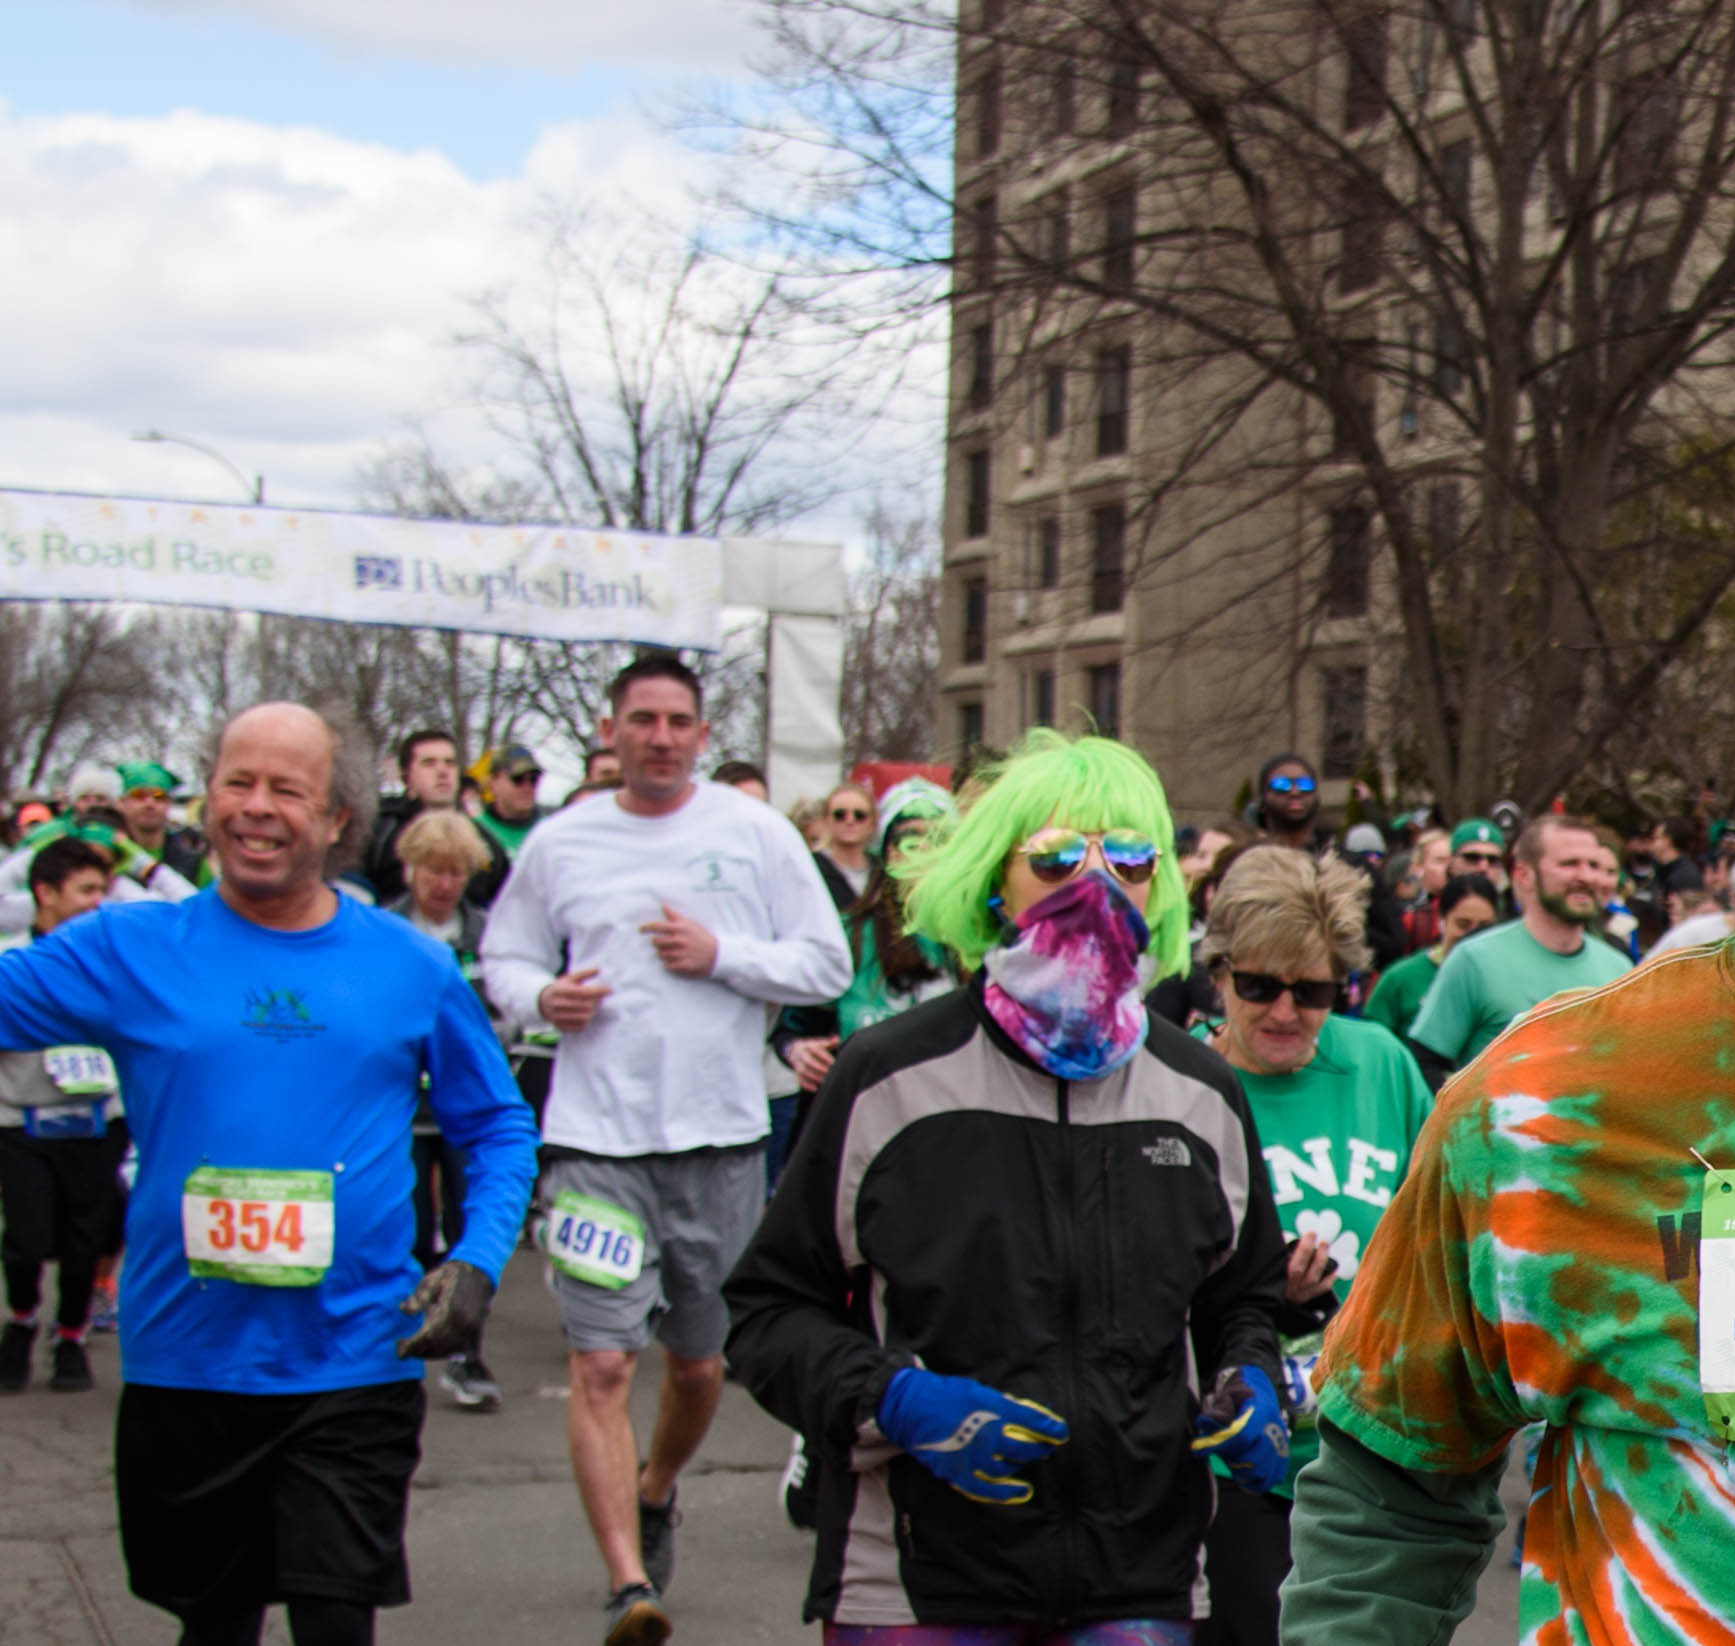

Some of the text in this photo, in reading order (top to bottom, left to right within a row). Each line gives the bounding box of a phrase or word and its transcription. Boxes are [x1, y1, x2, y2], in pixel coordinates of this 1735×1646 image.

[41, 531, 156, 571] Road
[172, 541, 274, 581] Race
[412, 558, 658, 613] PeoplesBank
[208, 1196, 307, 1253] 354
[556, 1216, 632, 1268] 4916
